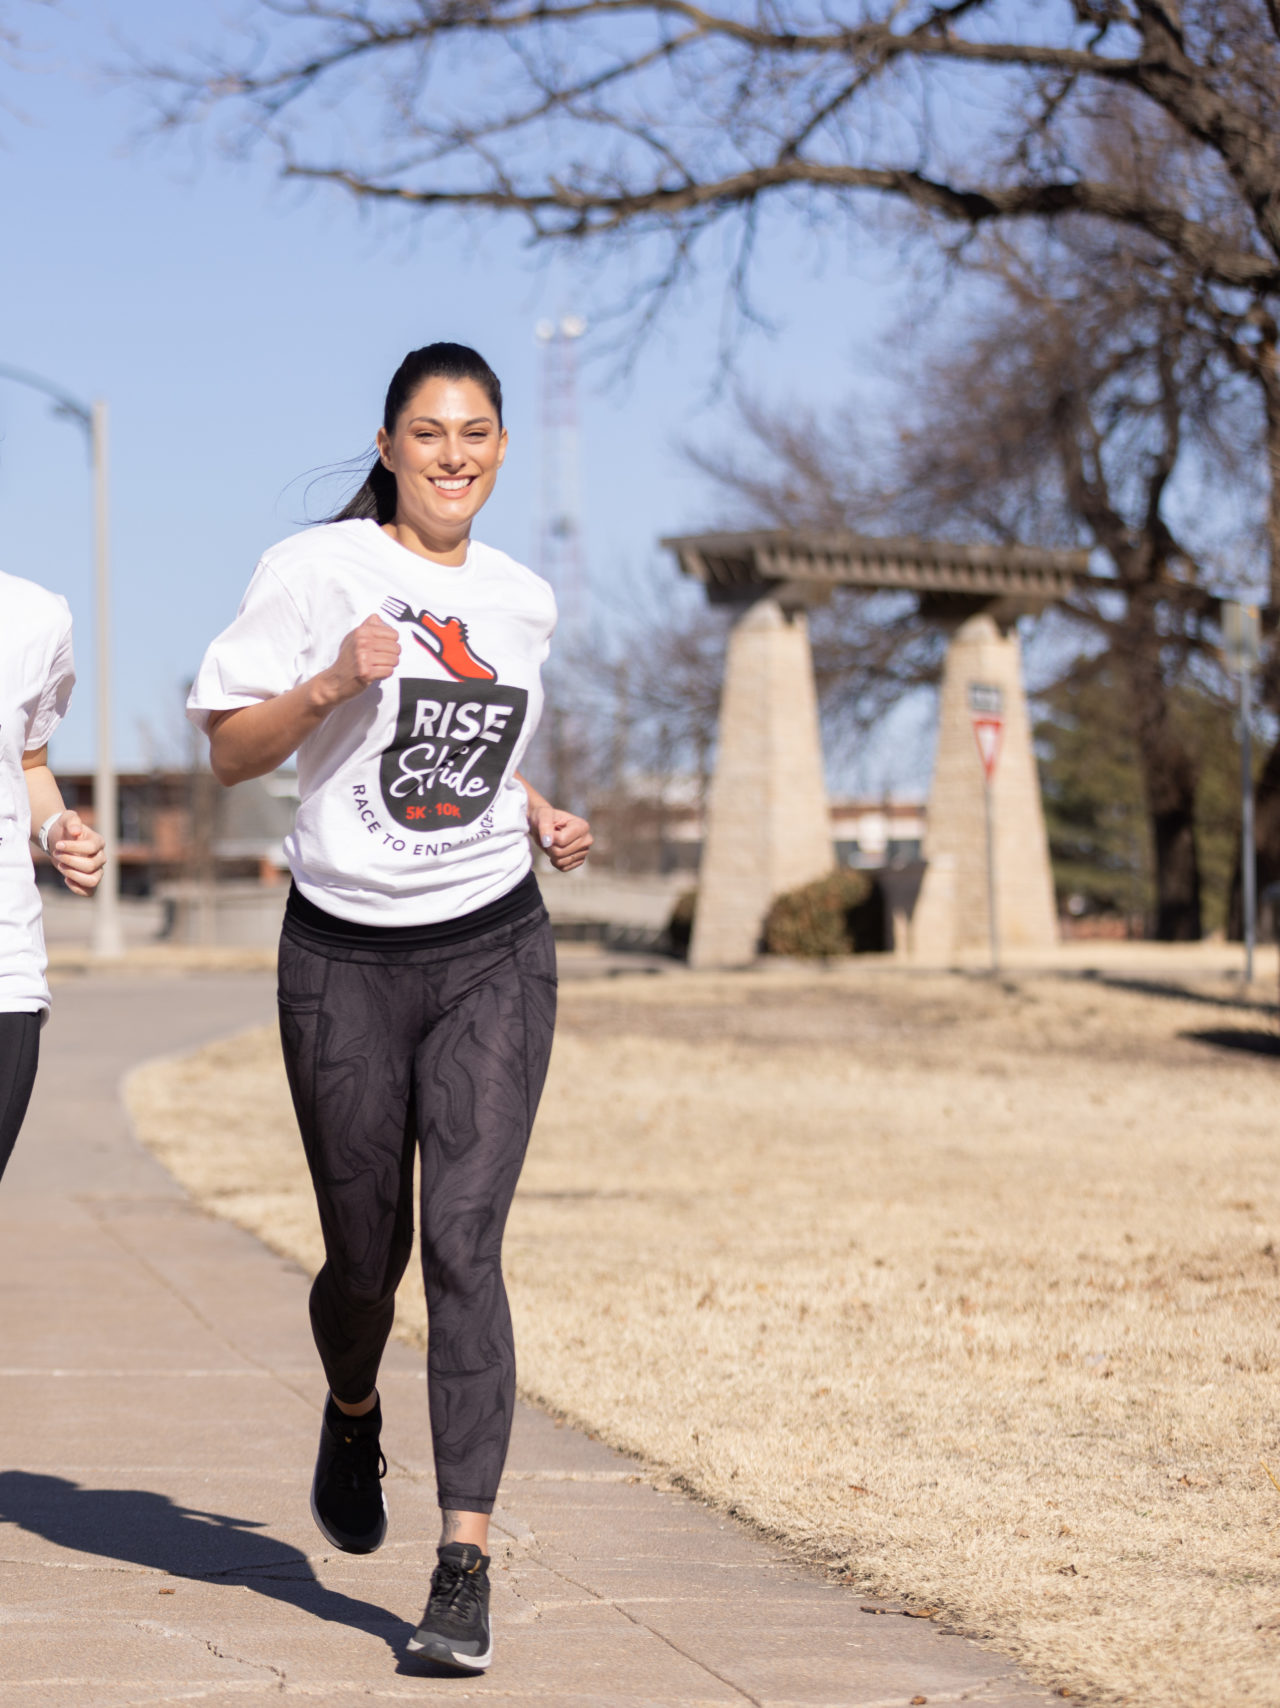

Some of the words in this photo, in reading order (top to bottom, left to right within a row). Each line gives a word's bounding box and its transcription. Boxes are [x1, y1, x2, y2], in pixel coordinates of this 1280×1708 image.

[410, 699, 513, 743] RISE
[353, 784, 382, 835] RACE
[383, 834, 405, 852] TO
[413, 842, 452, 856] END
[406, 806, 426, 820] 5K
